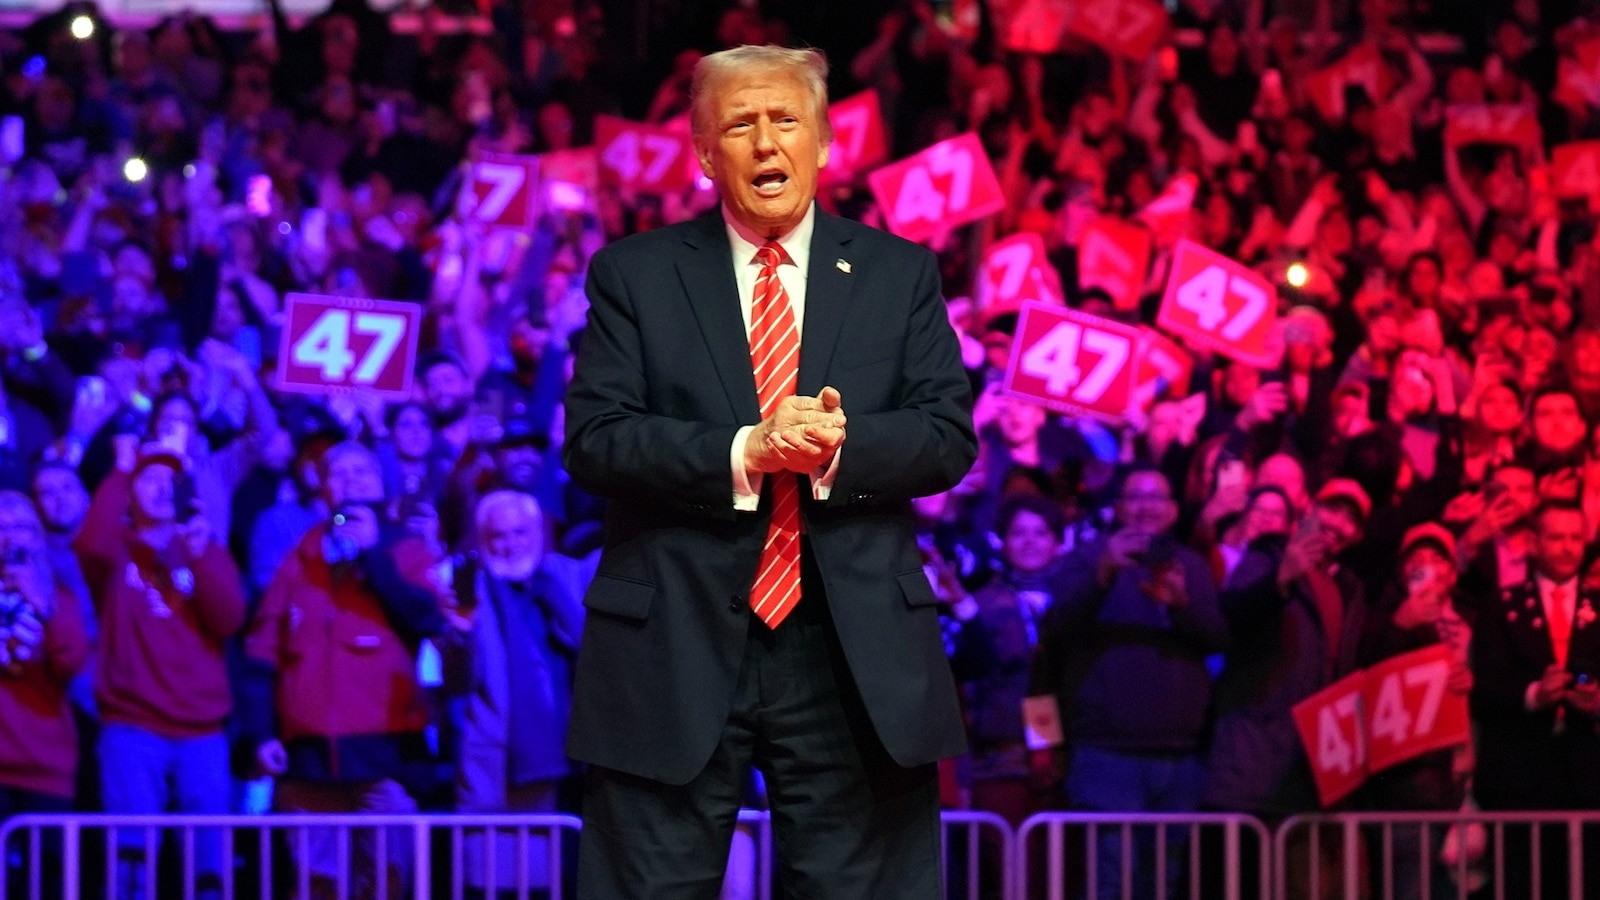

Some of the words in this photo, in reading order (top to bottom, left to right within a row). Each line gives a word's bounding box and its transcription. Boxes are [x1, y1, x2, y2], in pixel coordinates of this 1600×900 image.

[602, 129, 682, 184] 47
[895, 144, 974, 224] 47
[1176, 264, 1268, 341] 47
[291, 308, 407, 385] 47
[1020, 321, 1131, 404] 47
[1371, 659, 1451, 745] 47
